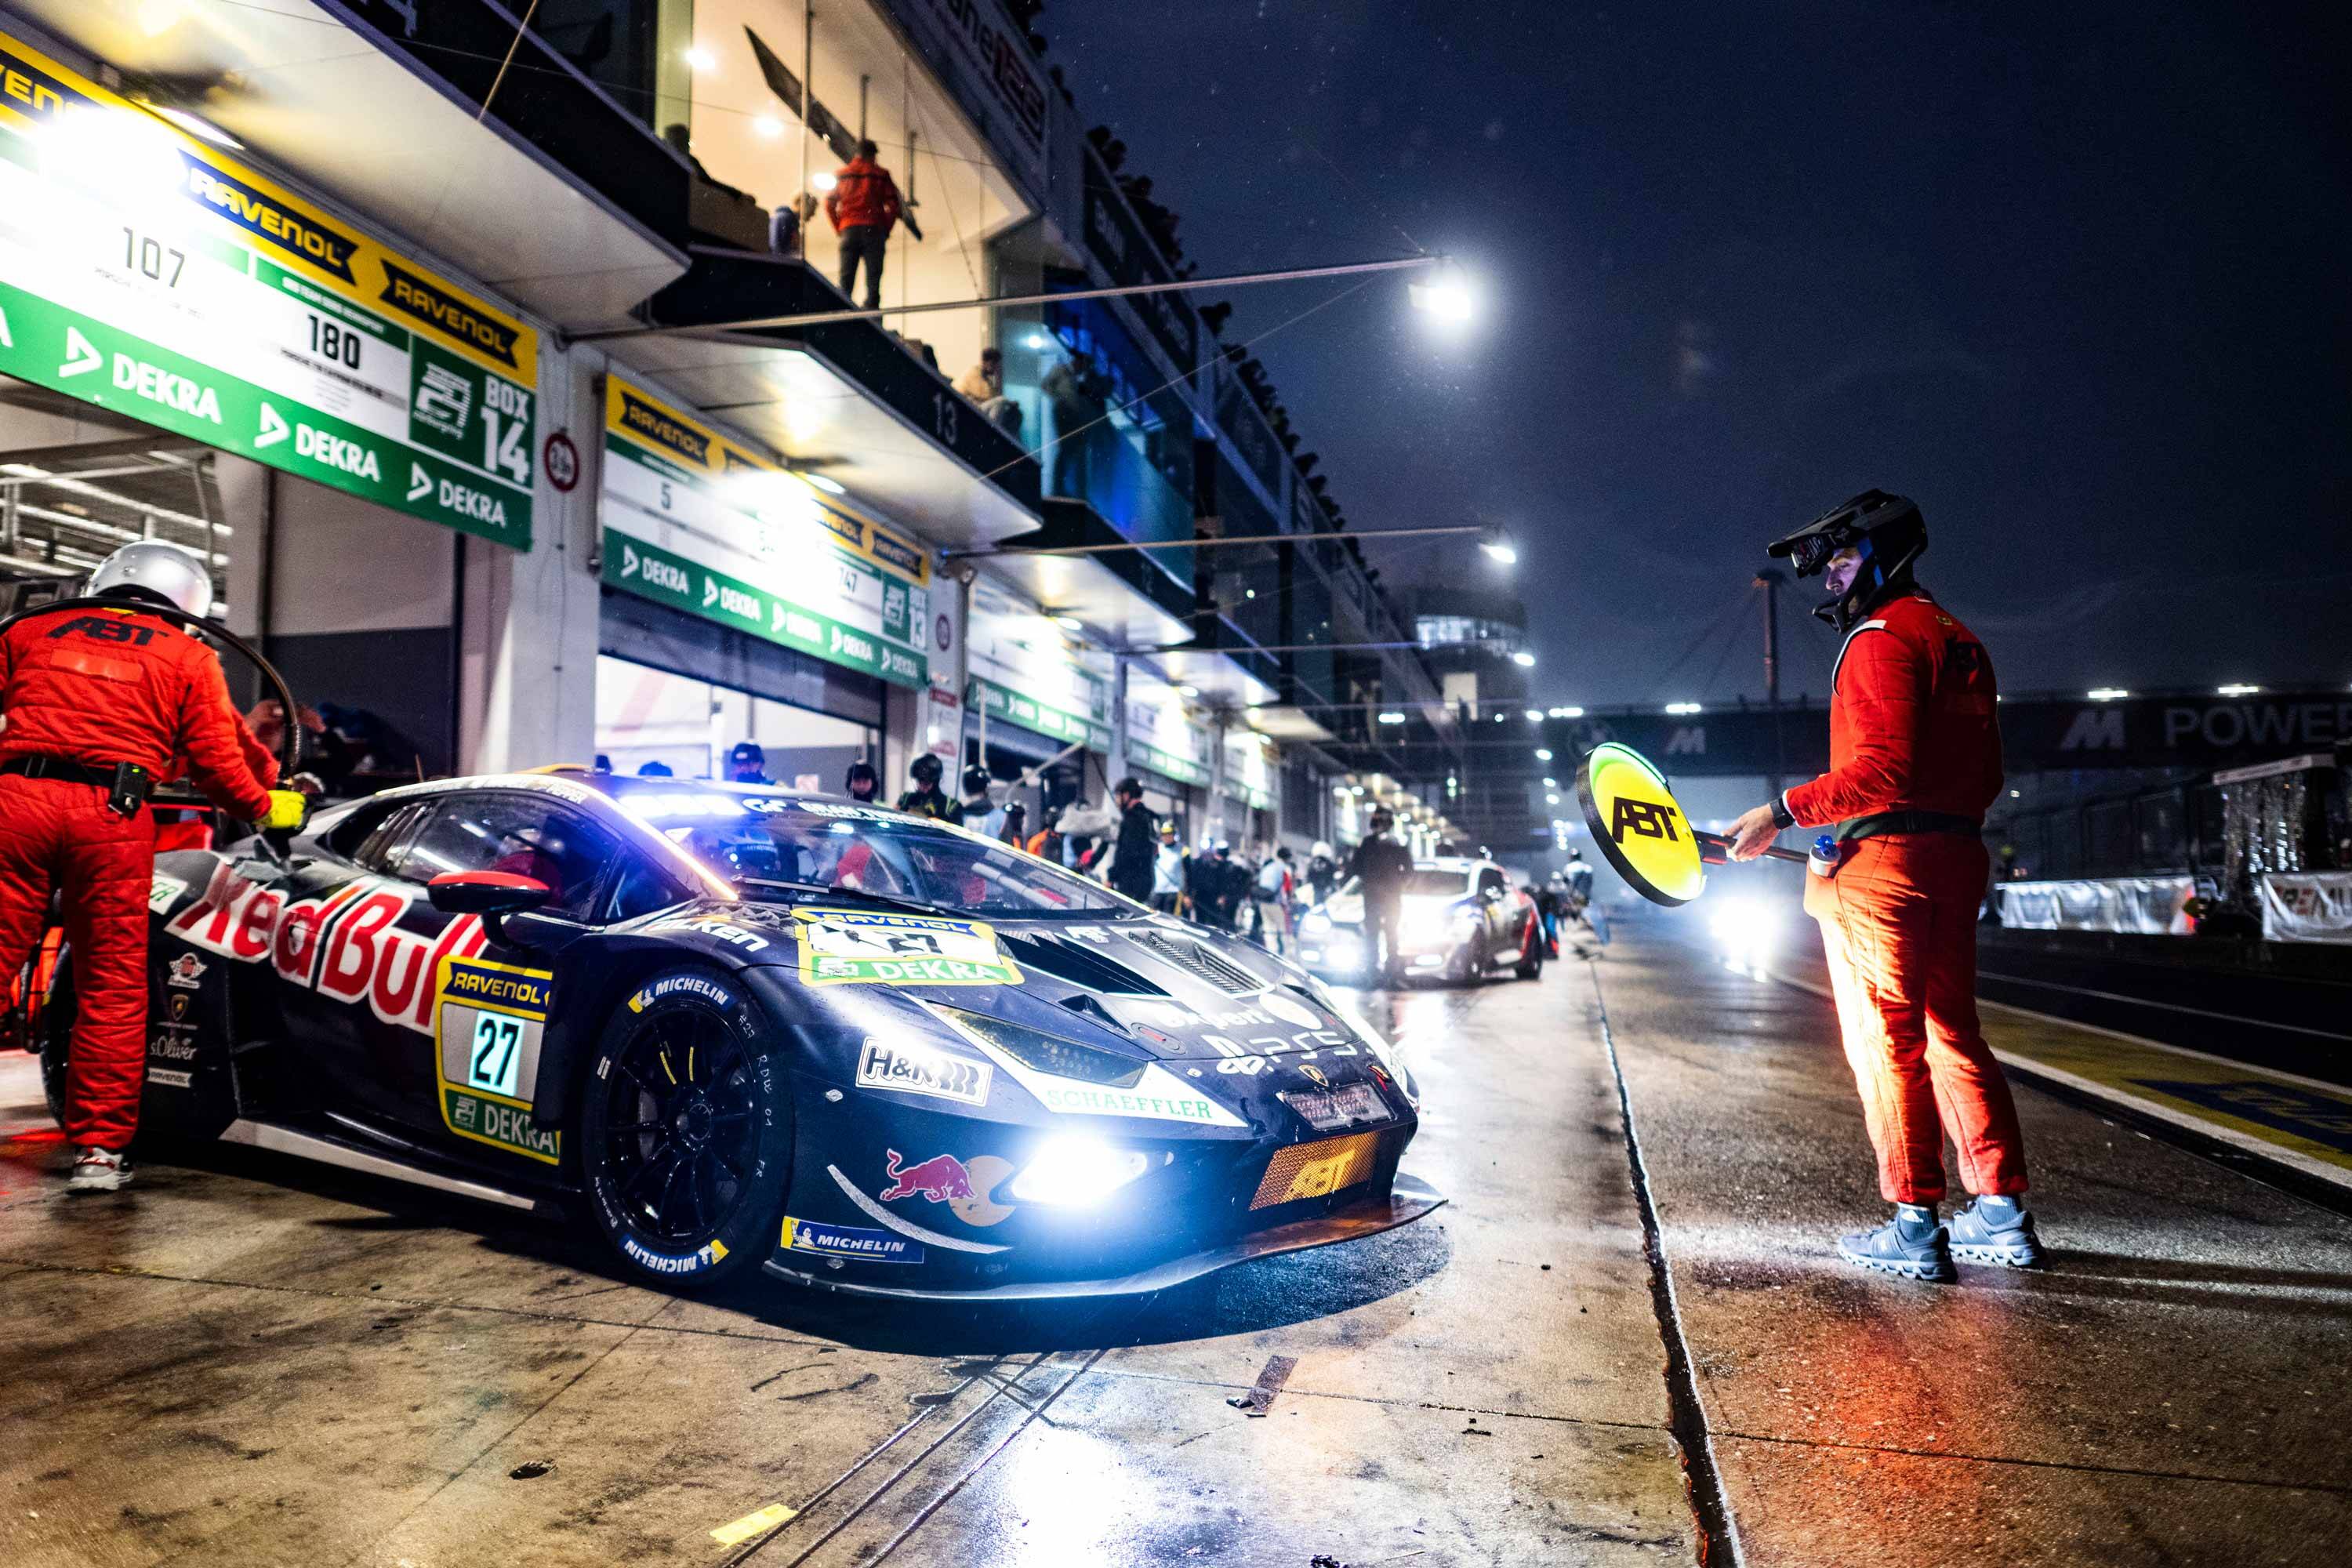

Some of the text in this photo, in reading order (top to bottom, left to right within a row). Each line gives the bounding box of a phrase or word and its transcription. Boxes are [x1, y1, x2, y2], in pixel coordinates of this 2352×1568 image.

[190, 167, 343, 267] RAVENOL
[123, 226, 185, 289] 107
[394, 278, 508, 354] RAVENOL
[308, 314, 361, 370] 180
[113, 353, 222, 424] DEKRA
[485, 374, 529, 423] BOX
[628, 405, 703, 457] RAVENOL
[932, 392, 959, 445] 13
[296, 423, 381, 482] DEKRA
[480, 406, 530, 485] 14
[439, 480, 506, 528] DEKRA
[661, 482, 672, 510] 5
[641, 557, 689, 594] DEKRA
[720, 586, 762, 622] DEKRA
[46, 615, 168, 646] ABT
[909, 606, 926, 648] 13
[1612, 797, 1678, 844] ABT
[824, 913, 967, 932] RAVENOL
[174, 863, 488, 1027] Red Bul
[454, 971, 541, 1004] RAVENOL
[870, 959, 1005, 980] DEKRA
[655, 978, 728, 1006] MICHELIN
[151, 1035, 196, 1060] s.Oliver
[473, 1018, 521, 1087] 27
[1249, 1030, 1358, 1065] PS5
[1047, 1089, 1214, 1120] SCHAEFFLER
[624, 1240, 698, 1273] MICHELIN
[816, 1234, 906, 1253] MICHELIN
